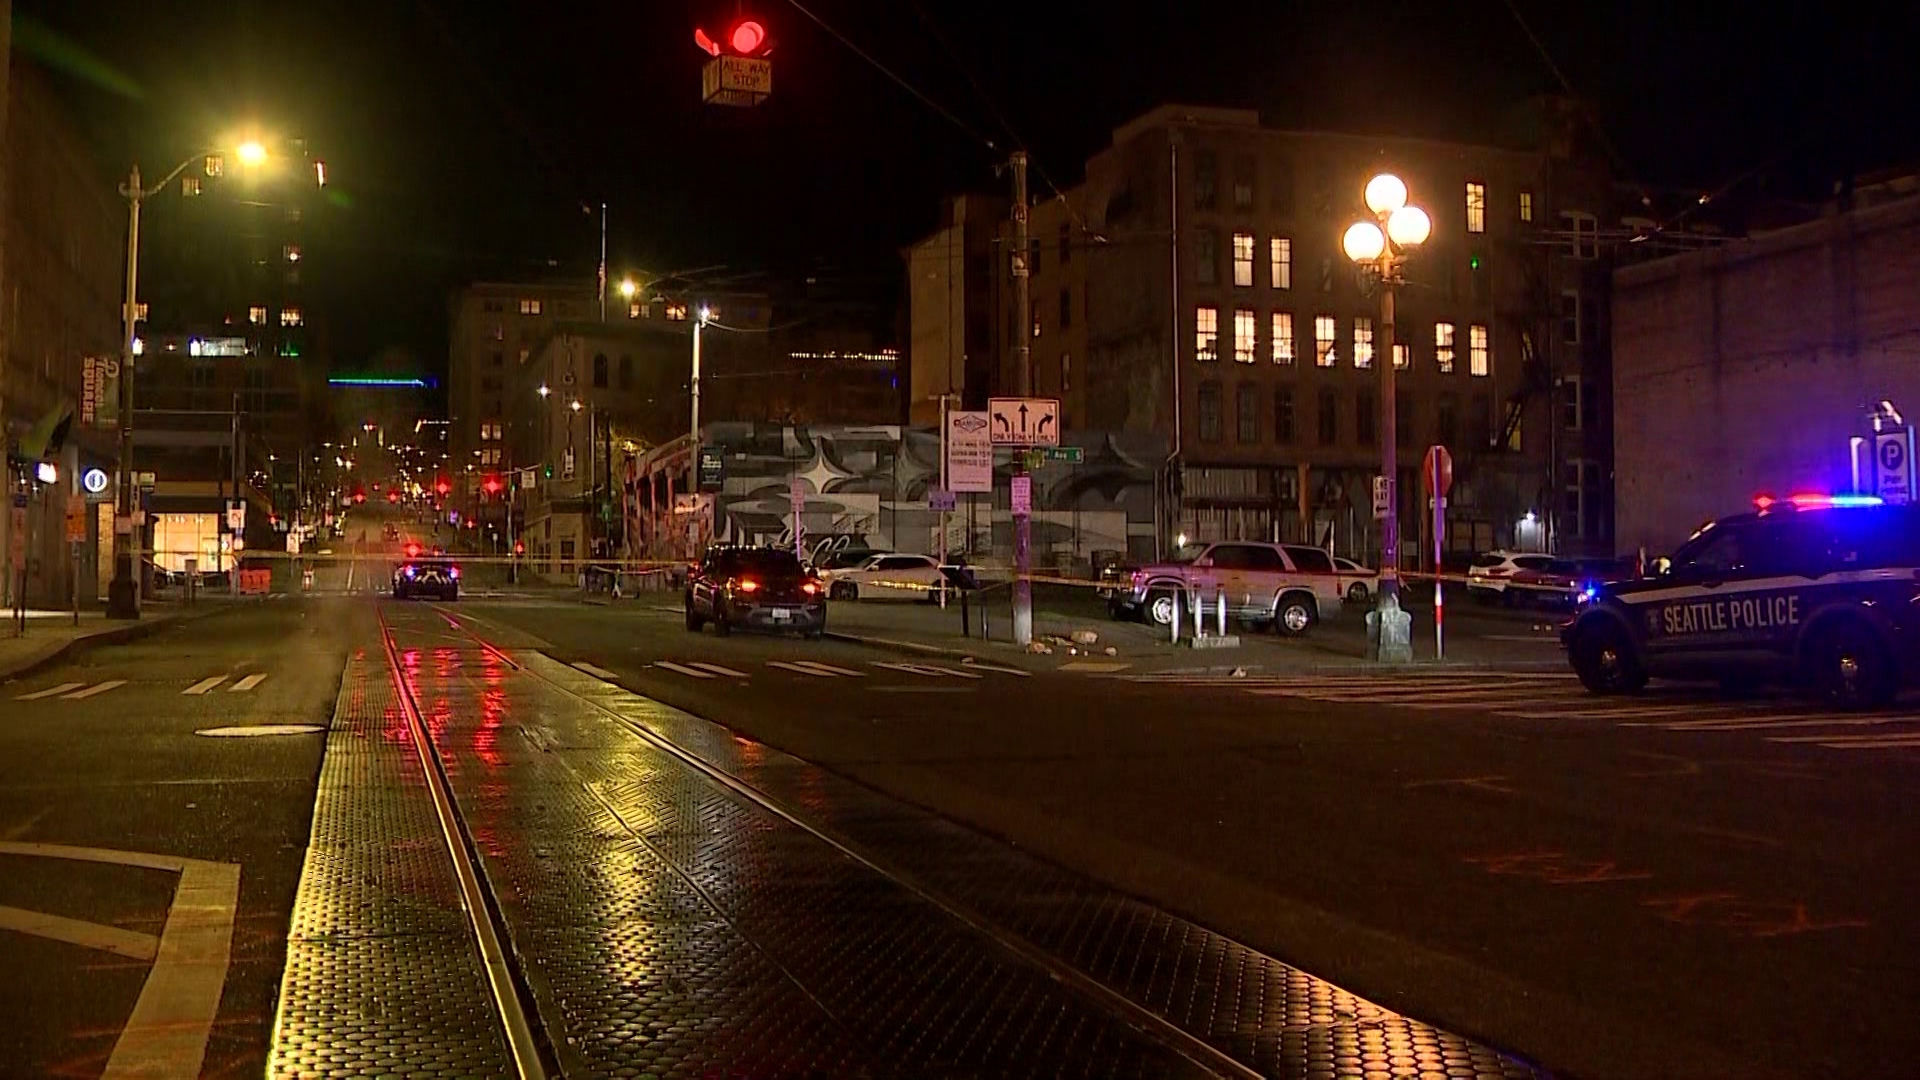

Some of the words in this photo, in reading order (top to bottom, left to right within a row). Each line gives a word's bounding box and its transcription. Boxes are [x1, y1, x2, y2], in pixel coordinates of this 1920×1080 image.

[723, 61, 742, 72] ALL
[749, 63, 770, 74] WAY
[733, 74, 760, 87] STOP
[82, 357, 95, 424] SQUARE
[993, 433, 1010, 441] ONLY
[1014, 433, 1032, 441] ONLY
[1037, 434, 1054, 442] ONLY
[1885, 444, 1900, 467] P
[1663, 602, 1728, 634] SEATTLE
[1730, 594, 1800, 629] POLICE
